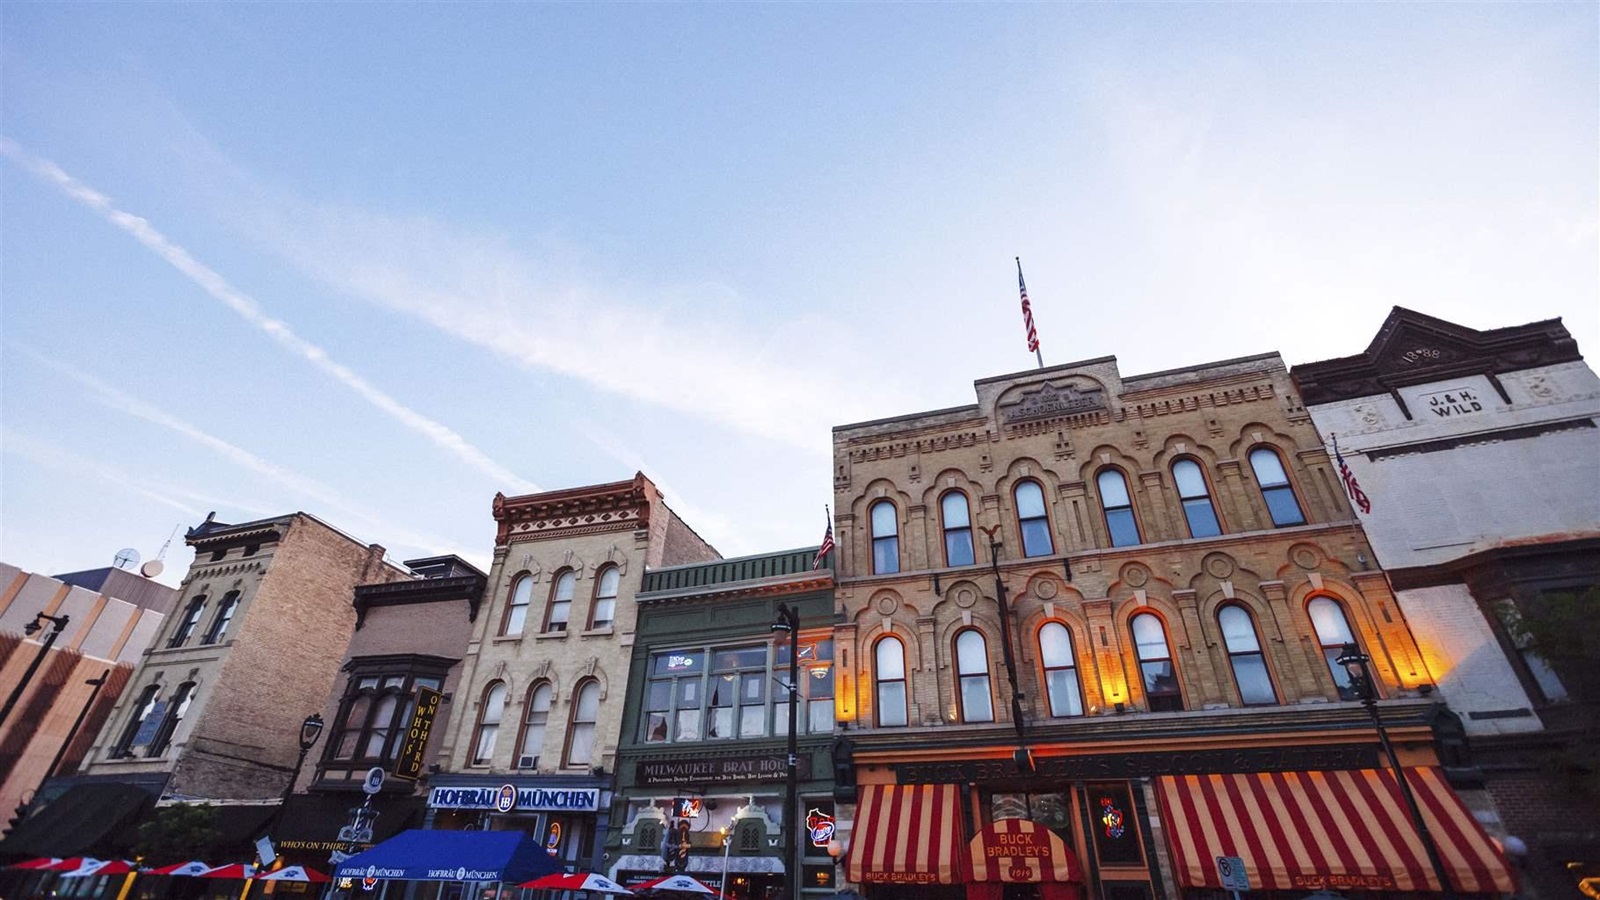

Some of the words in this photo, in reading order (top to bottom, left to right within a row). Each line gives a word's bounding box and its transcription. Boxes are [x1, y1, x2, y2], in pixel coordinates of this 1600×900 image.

[1429, 396, 1445, 406] J.
[1445, 394, 1457, 404] &
[1459, 391, 1478, 402] H.
[1431, 401, 1482, 417] WILD
[427, 695, 438, 715] ON
[406, 706, 426, 755] WHO'S
[410, 720, 431, 772] THIRD
[644, 762, 716, 776] MILWAUKEE
[723, 760, 753, 773] BRAT
[433, 788, 498, 805] HOFBRÄU
[517, 789, 595, 808] MÜNCHEN
[281, 840, 306, 849] WHO'S
[306, 841, 320, 849] ON
[1000, 834, 1033, 845] BUCK
[987, 846, 1050, 857] BRADLEY'S
[374, 867, 406, 877] MÜNCHEN
[465, 869, 498, 880] MÜNCHEN
[866, 872, 889, 881] BUCK
[891, 872, 937, 882] BRADLEY'S
[1295, 876, 1326, 886] BUCK
[1330, 875, 1392, 887] BRADLEY'S
